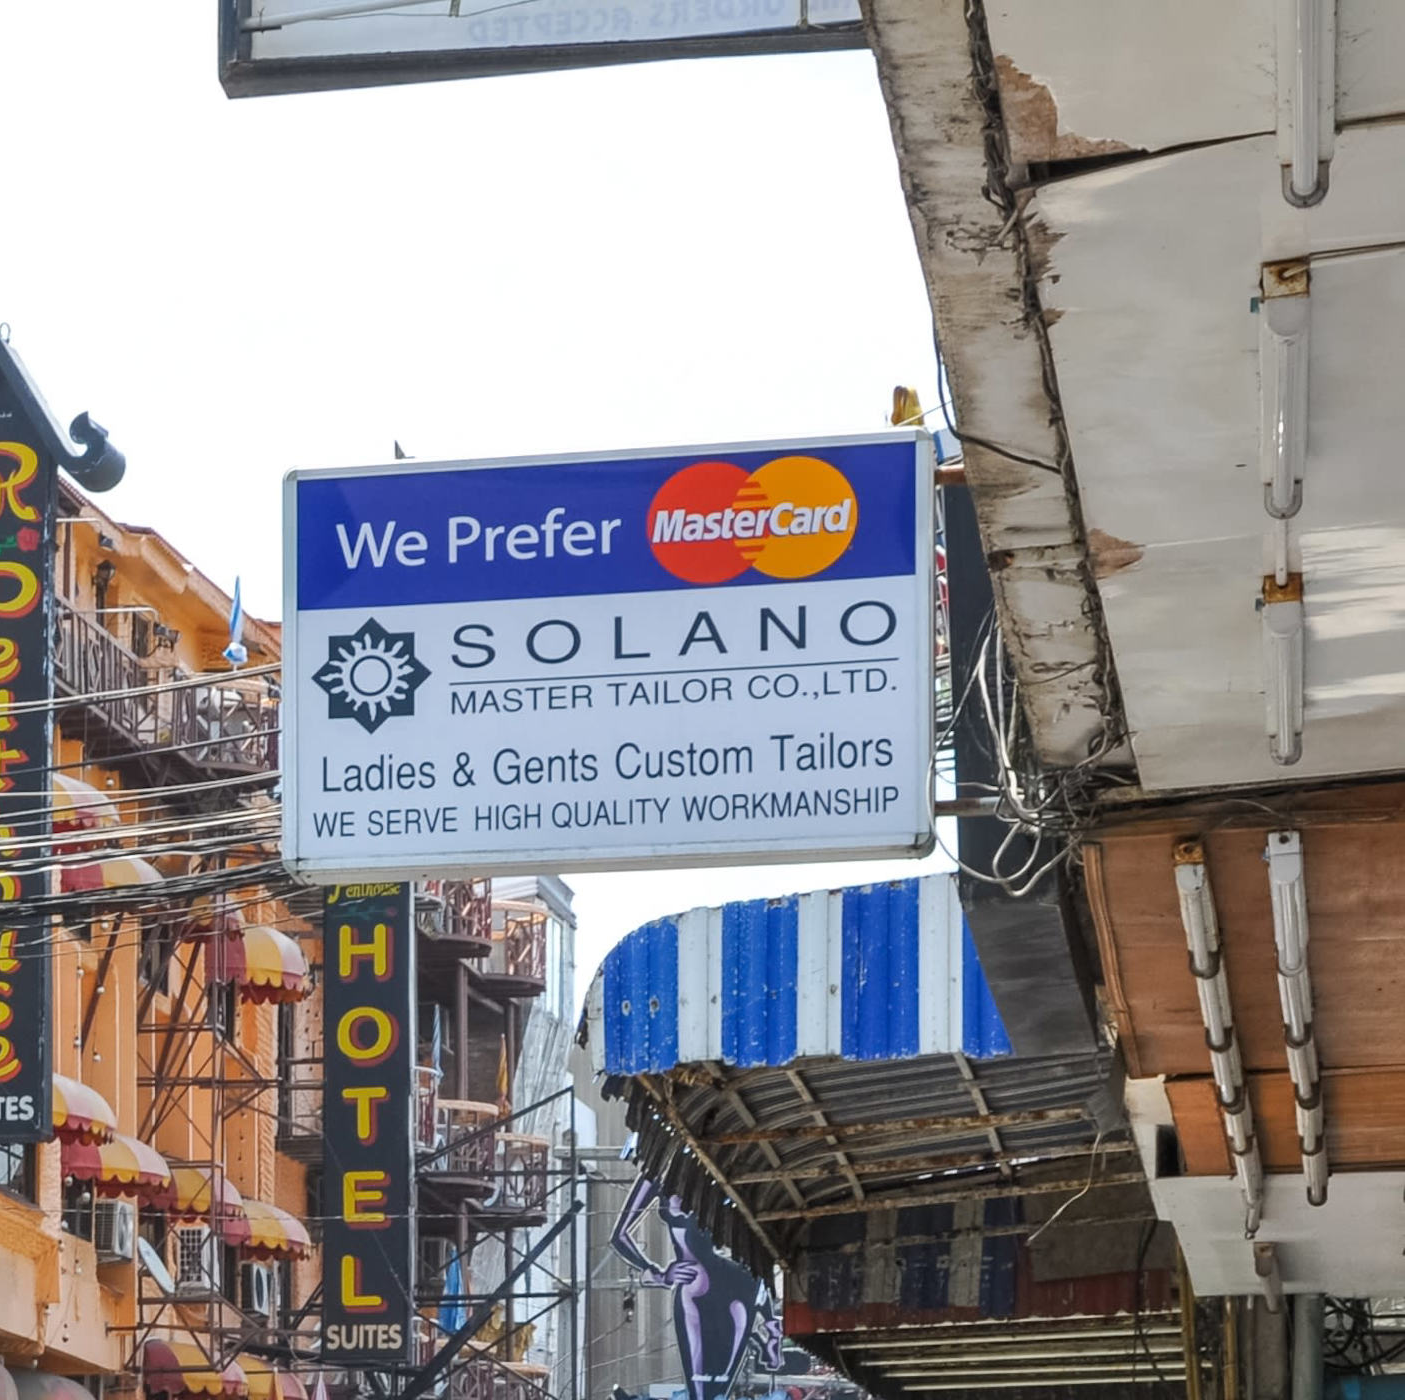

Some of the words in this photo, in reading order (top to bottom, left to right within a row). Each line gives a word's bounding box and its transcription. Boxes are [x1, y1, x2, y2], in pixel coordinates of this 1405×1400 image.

[336, 520, 429, 569] We
[447, 507, 622, 563] Prefer
[651, 498, 852, 545] MasterCard
[450, 600, 898, 669] SOLANO
[450, 683, 593, 715] MASTER
[606, 677, 733, 707] TAILOR
[321, 752, 436, 793] Ladies
[451, 752, 476, 787] &
[492, 746, 598, 785] Gents
[614, 740, 753, 780] Custom
[770, 732, 893, 773] Tailors
[314, 811, 356, 838] WE
[368, 807, 459, 836] SERVE
[474, 804, 542, 831] HIGH
[552, 798, 670, 831] QUALITY
[682, 785, 899, 823] WORKMANSHIP
[337, 924, 399, 1313] HOTEL
[327, 1323, 403, 1351] SUITES
